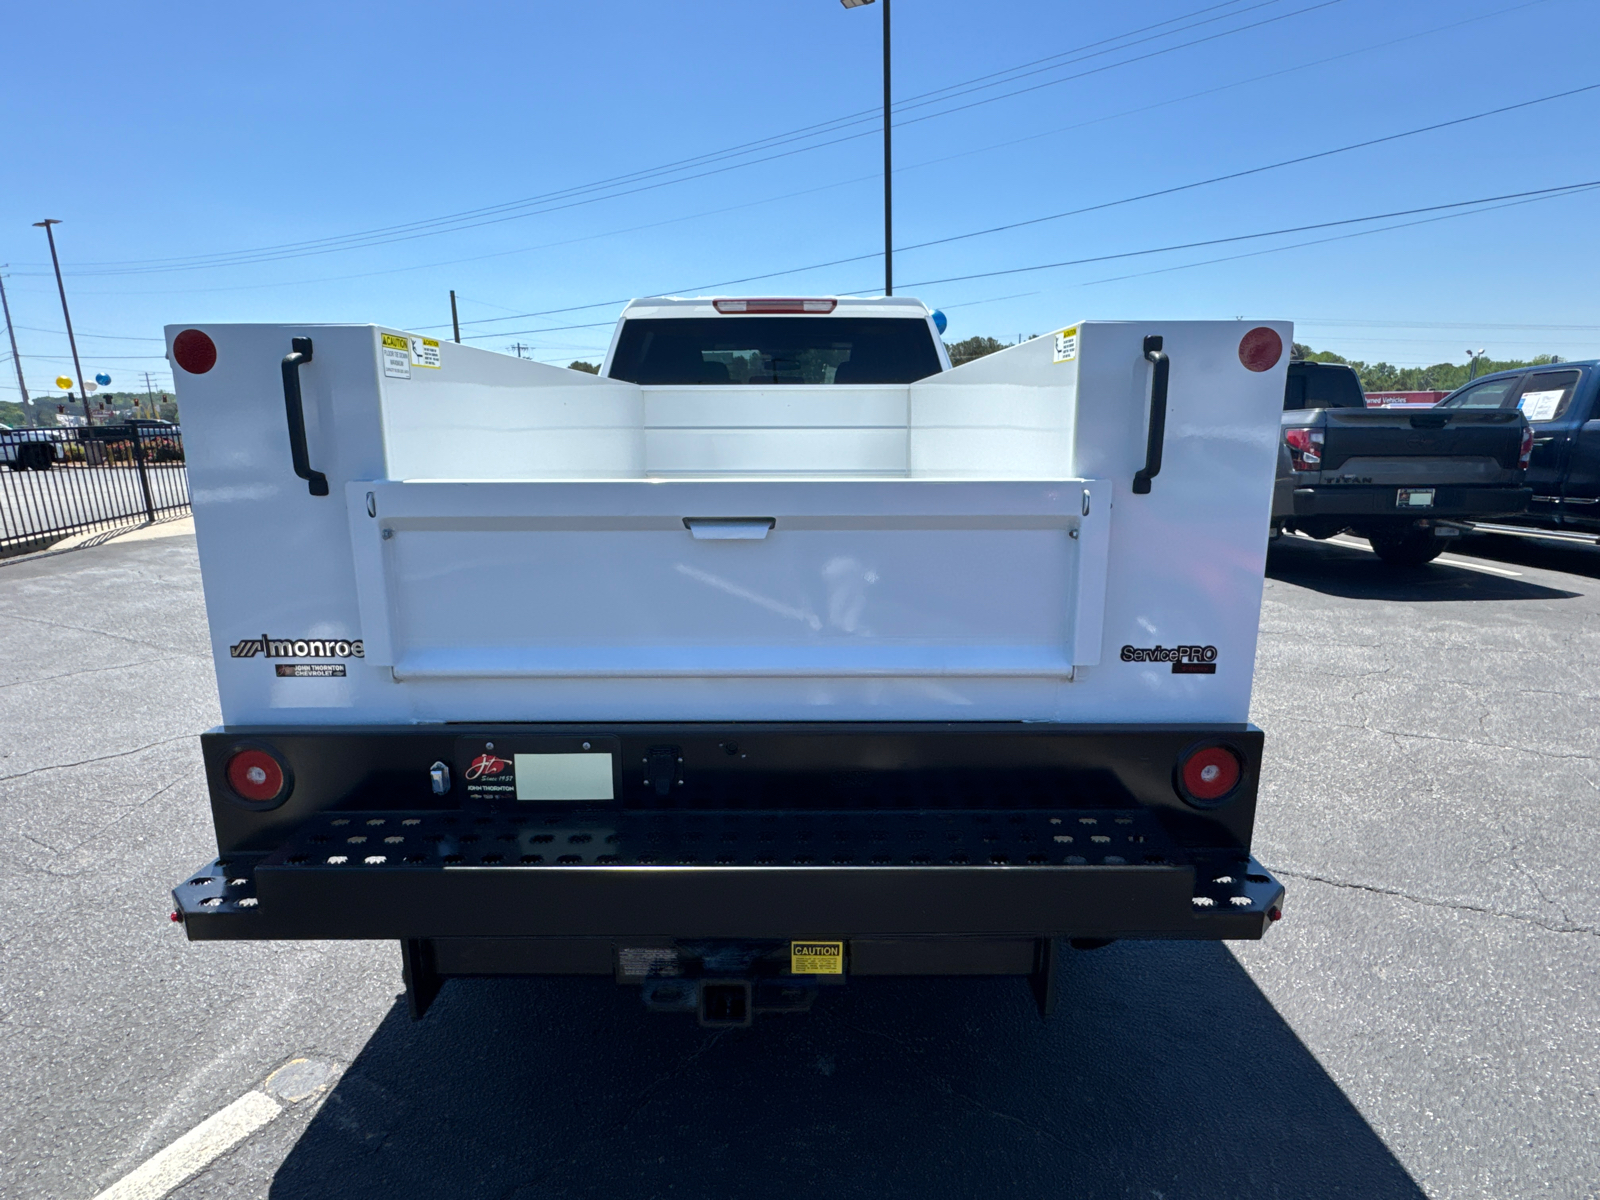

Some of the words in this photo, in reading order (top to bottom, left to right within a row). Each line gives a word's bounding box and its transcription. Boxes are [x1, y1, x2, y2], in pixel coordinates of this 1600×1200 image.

[387, 336, 408, 349] CAUTION
[268, 640, 364, 657] monroe
[1121, 646, 1217, 662] ServicePRO
[795, 947, 838, 955] CAUTION
